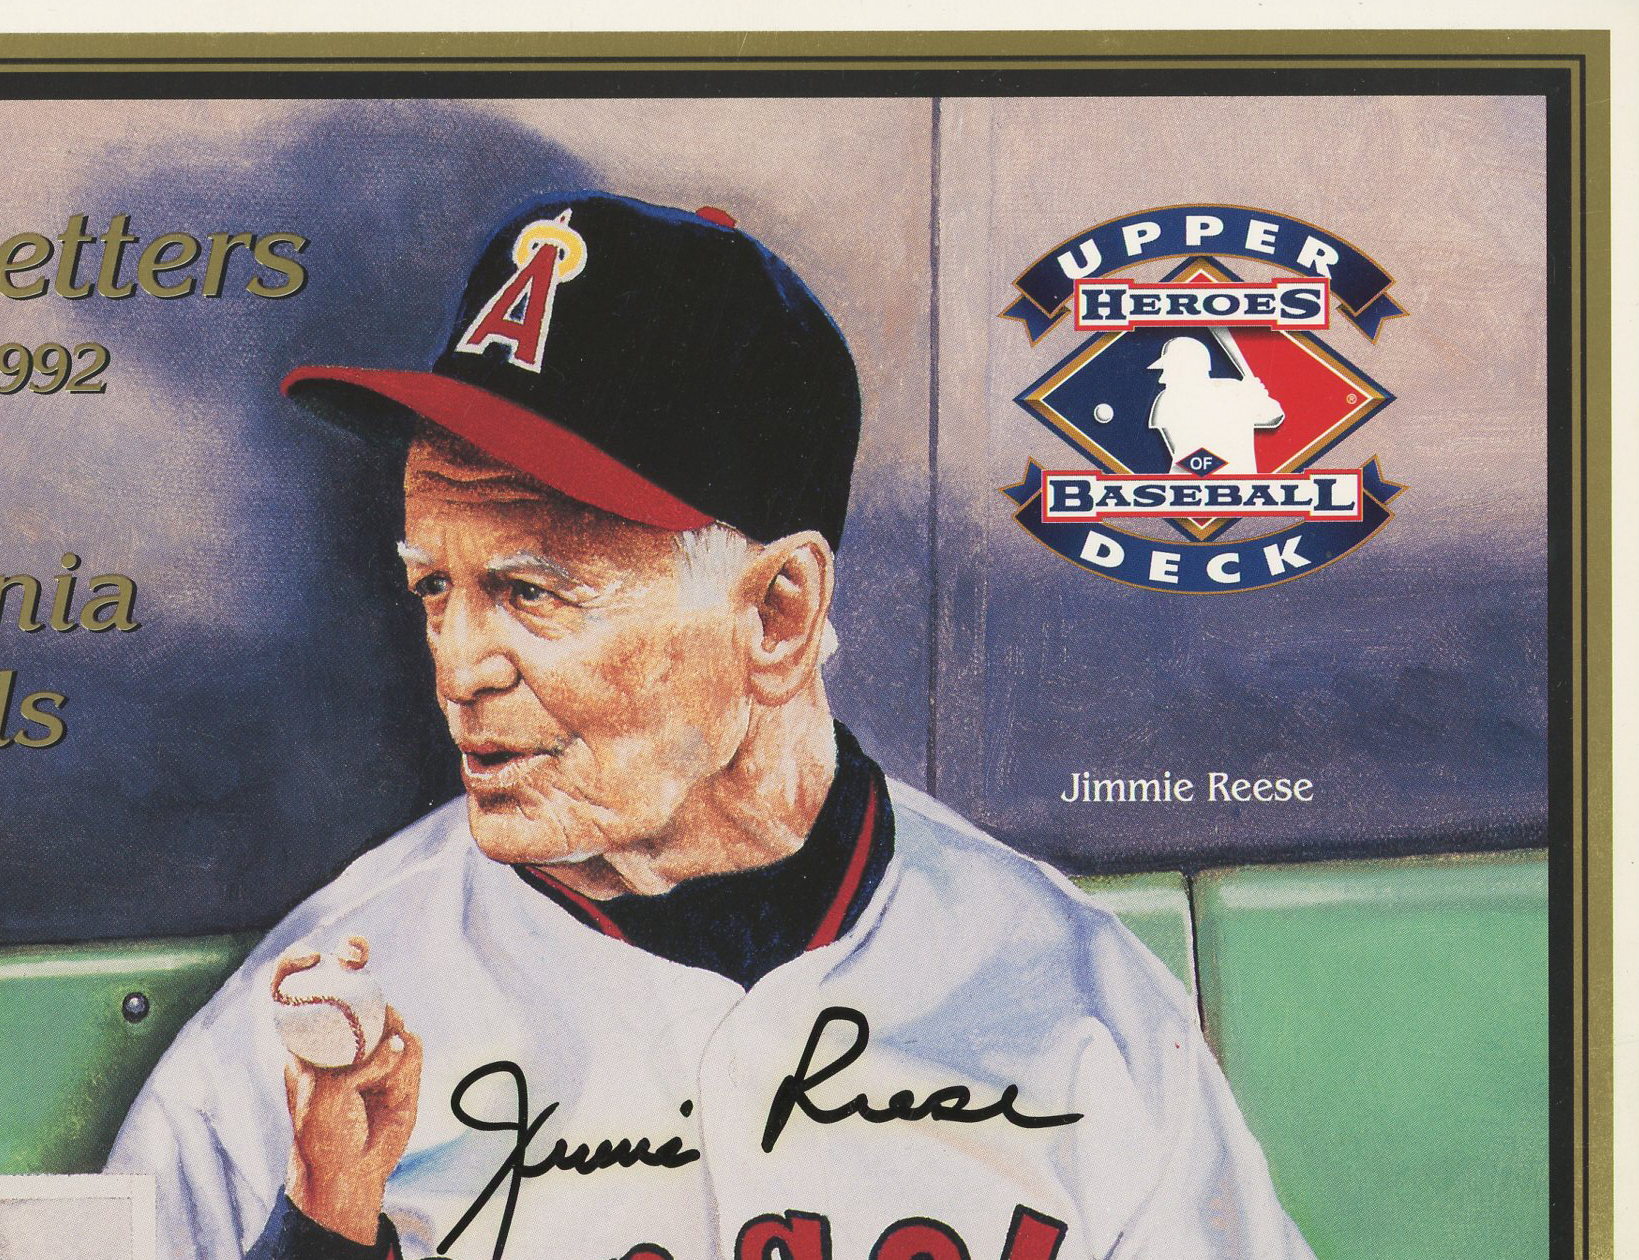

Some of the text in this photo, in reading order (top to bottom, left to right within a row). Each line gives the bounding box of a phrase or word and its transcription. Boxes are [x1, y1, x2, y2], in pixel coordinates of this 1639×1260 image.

[1057, 215, 1339, 279] UPPER
[1190, 457, 1213, 470] OF
[1079, 530, 1312, 584] DECK
[1060, 771, 1314, 802] Jimmie Reese
[760, 1006, 1085, 1154] Reese
